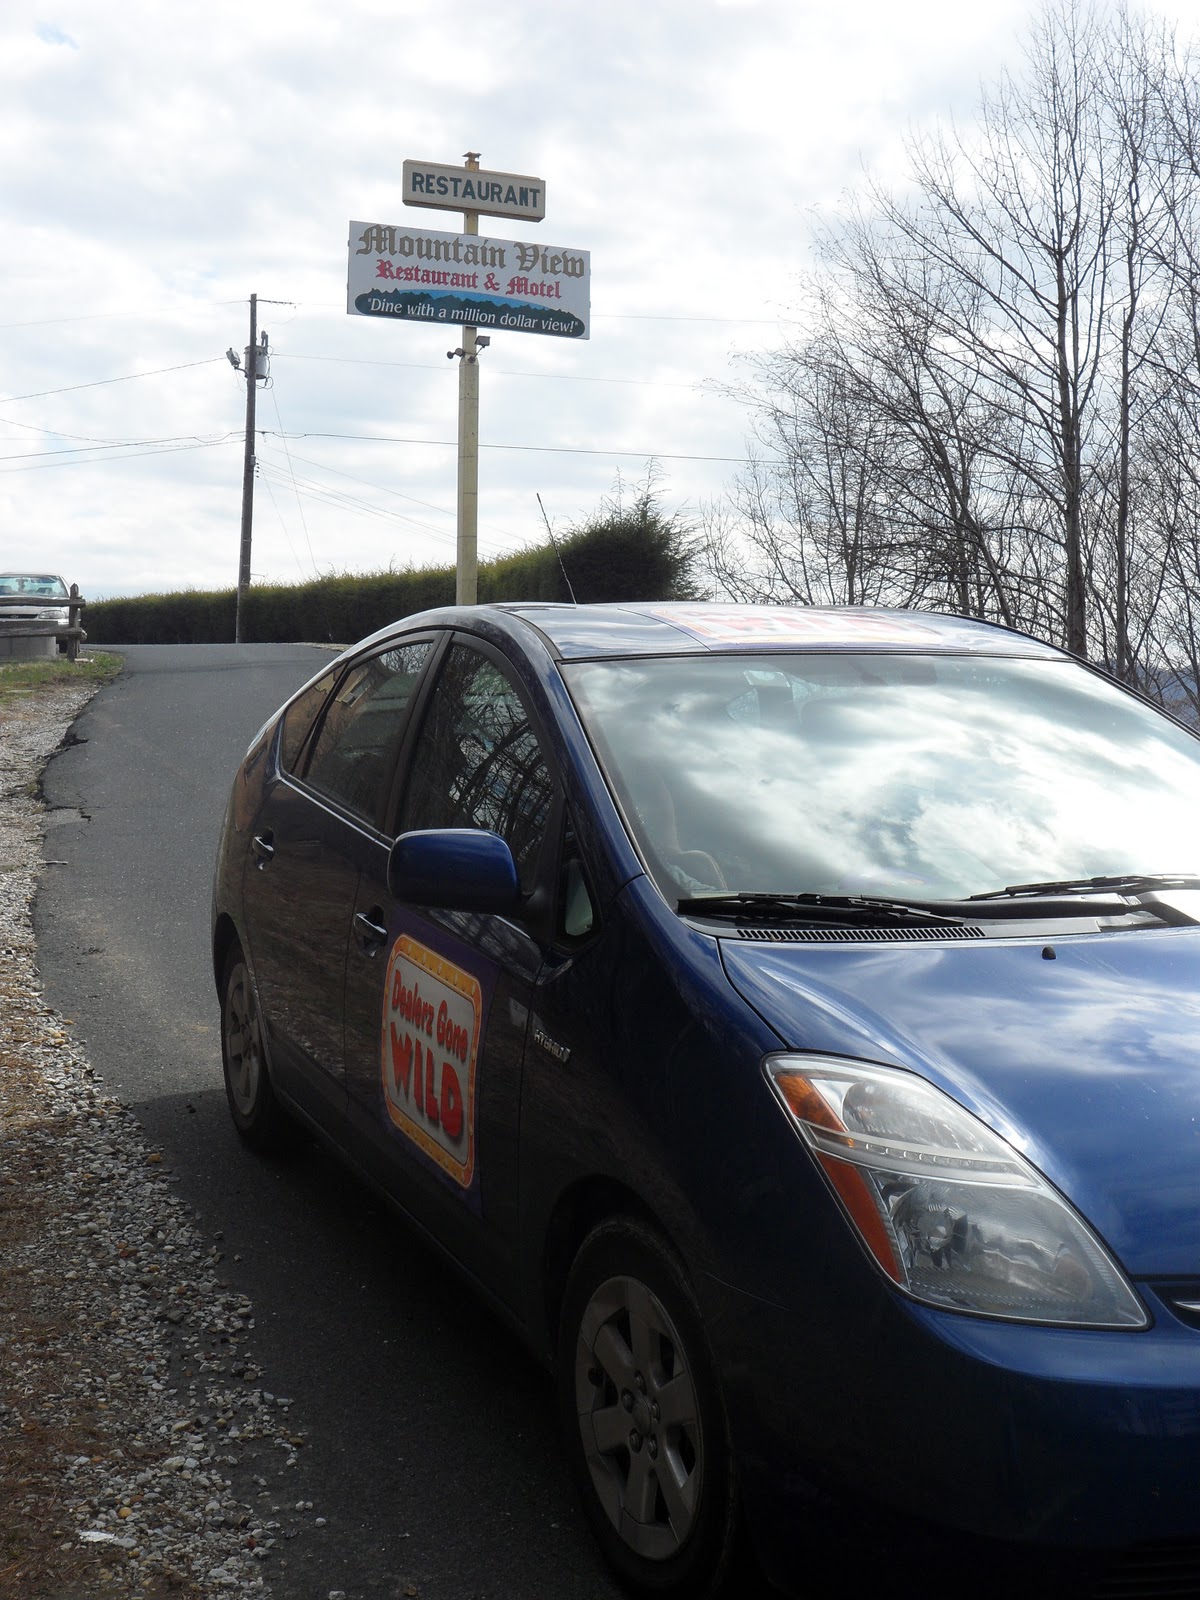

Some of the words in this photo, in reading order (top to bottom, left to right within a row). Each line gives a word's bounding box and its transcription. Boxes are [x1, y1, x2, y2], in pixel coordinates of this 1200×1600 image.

[411, 171, 541, 208] RESTAURANT
[355, 224, 507, 269] Mountain
[513, 241, 585, 279] View
[375, 258, 479, 289] Restaurant
[483, 272, 500, 291] &
[505, 275, 562, 299] Motel
[407, 301, 435, 317] with
[438, 307, 446, 318] a
[451, 306, 496, 324] million
[499, 310, 538, 329] dollar
[391, 968, 435, 1037] Dealerz
[436, 999, 468, 1063] Gone
[390, 1021, 464, 1138] WILD
